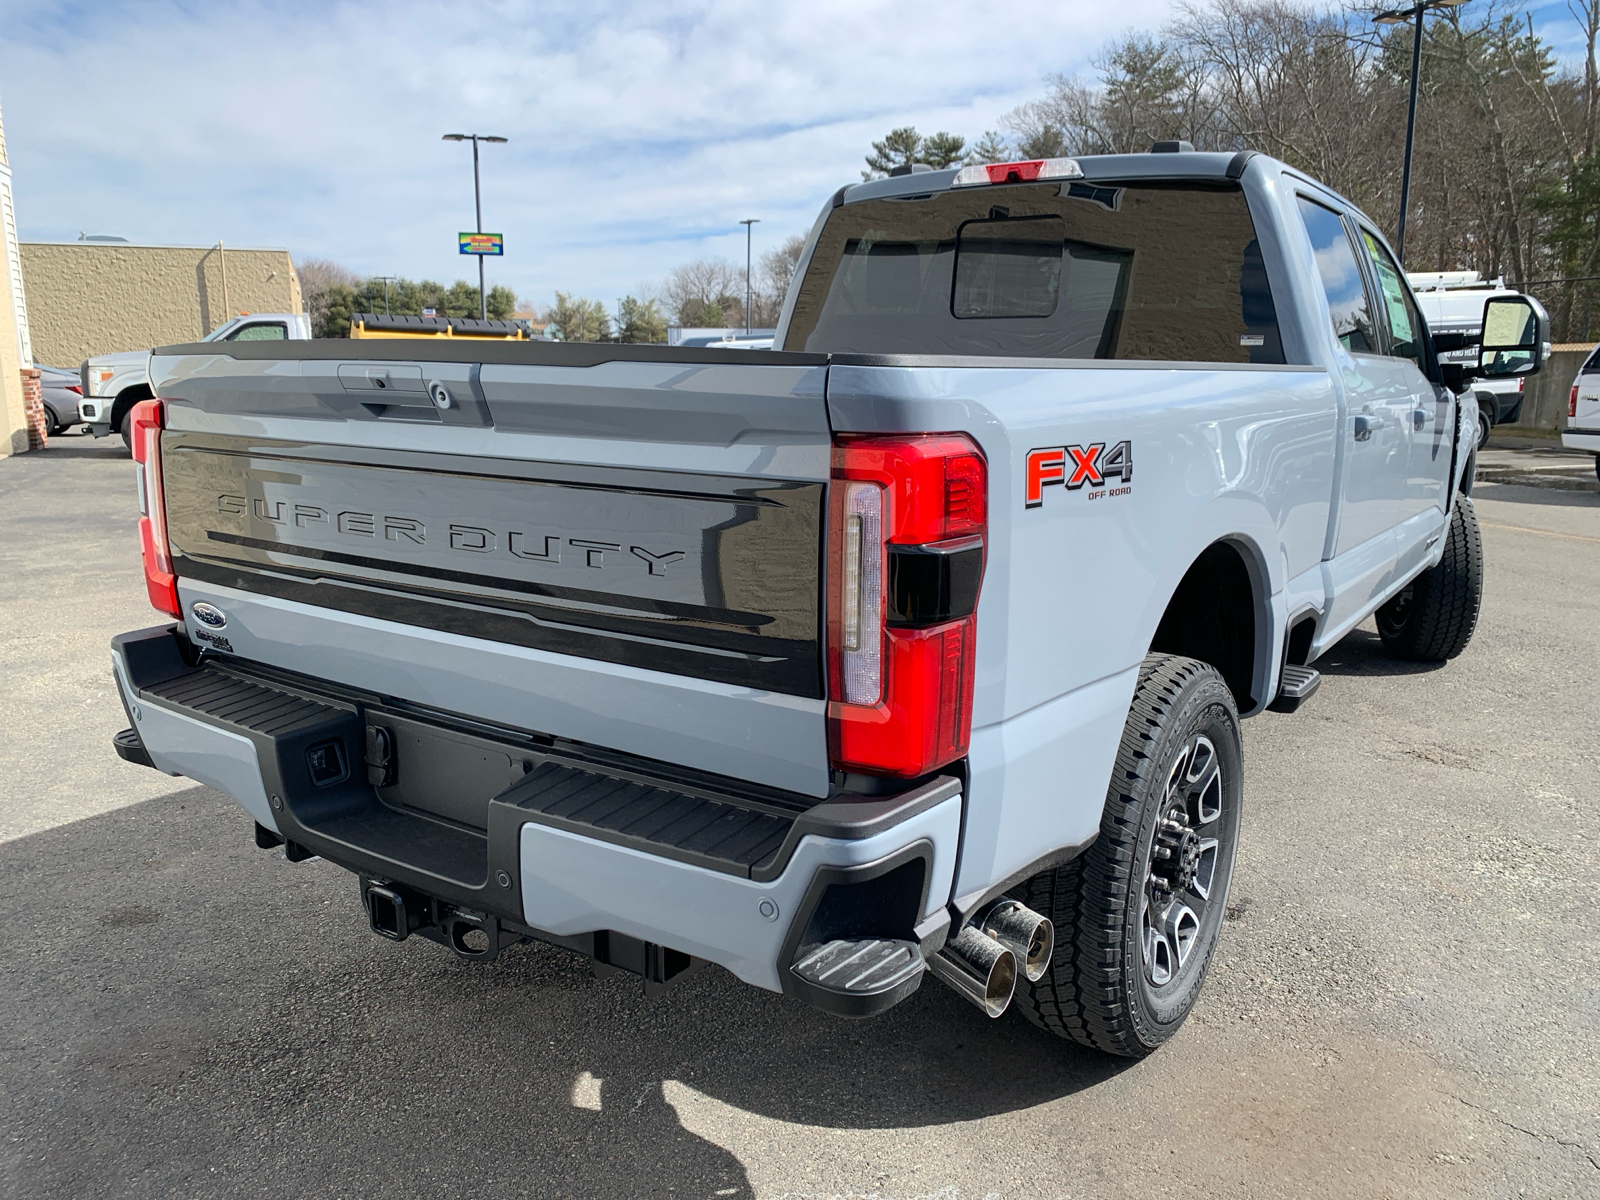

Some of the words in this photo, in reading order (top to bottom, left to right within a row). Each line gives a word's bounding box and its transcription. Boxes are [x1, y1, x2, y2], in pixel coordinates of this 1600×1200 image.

[1025, 440, 1132, 509] FX4
[1088, 490, 1106, 500] OFF
[1109, 486, 1131, 497] ROAD
[217, 494, 426, 545] SUPER
[449, 524, 685, 576] DUTY
